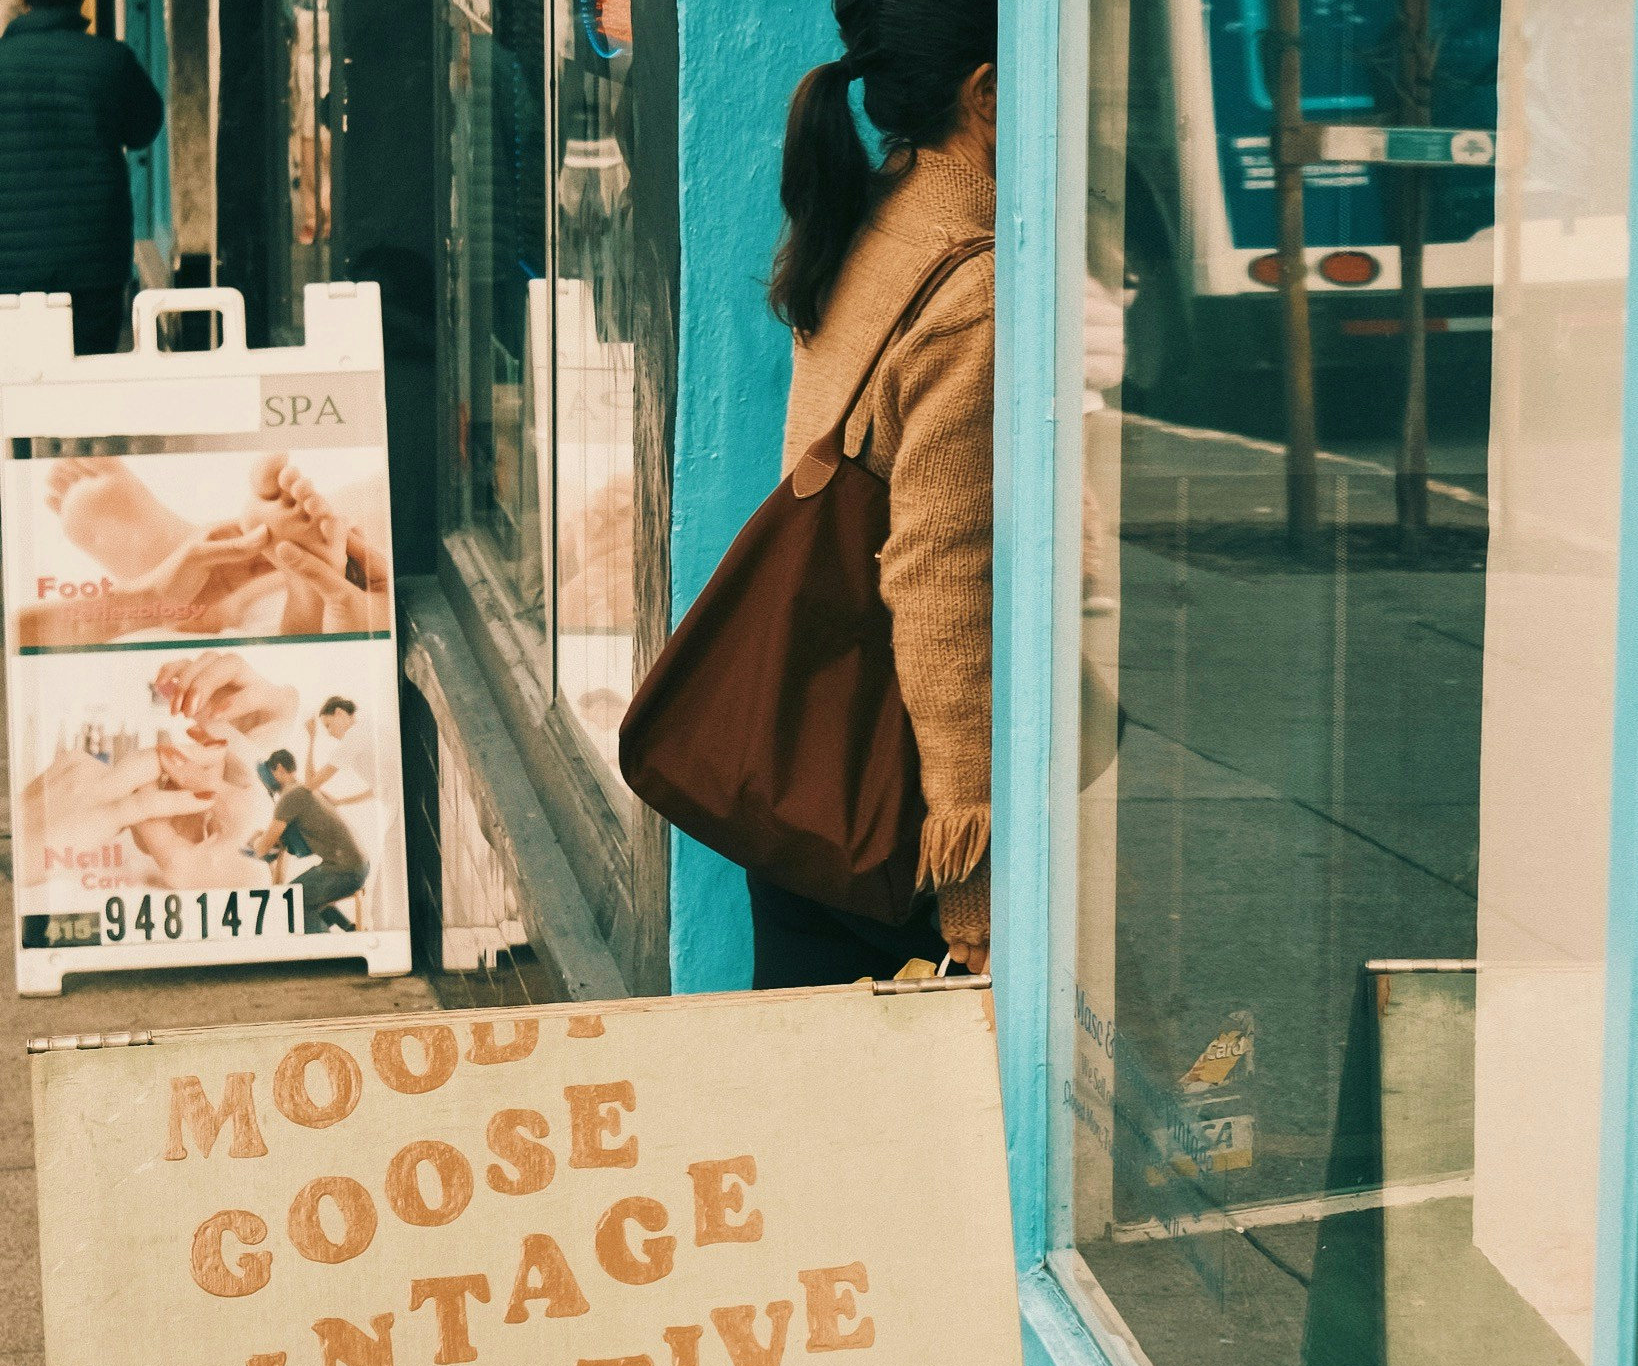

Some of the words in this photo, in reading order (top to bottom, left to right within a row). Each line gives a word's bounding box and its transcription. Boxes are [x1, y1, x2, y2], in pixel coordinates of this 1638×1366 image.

[264, 395, 346, 428] SPA
[37, 577, 114, 600] Foot
[44, 843, 123, 871] Nail
[165, 1016, 606, 1161] MOOD
[192, 1080, 640, 1298] GOOSE
